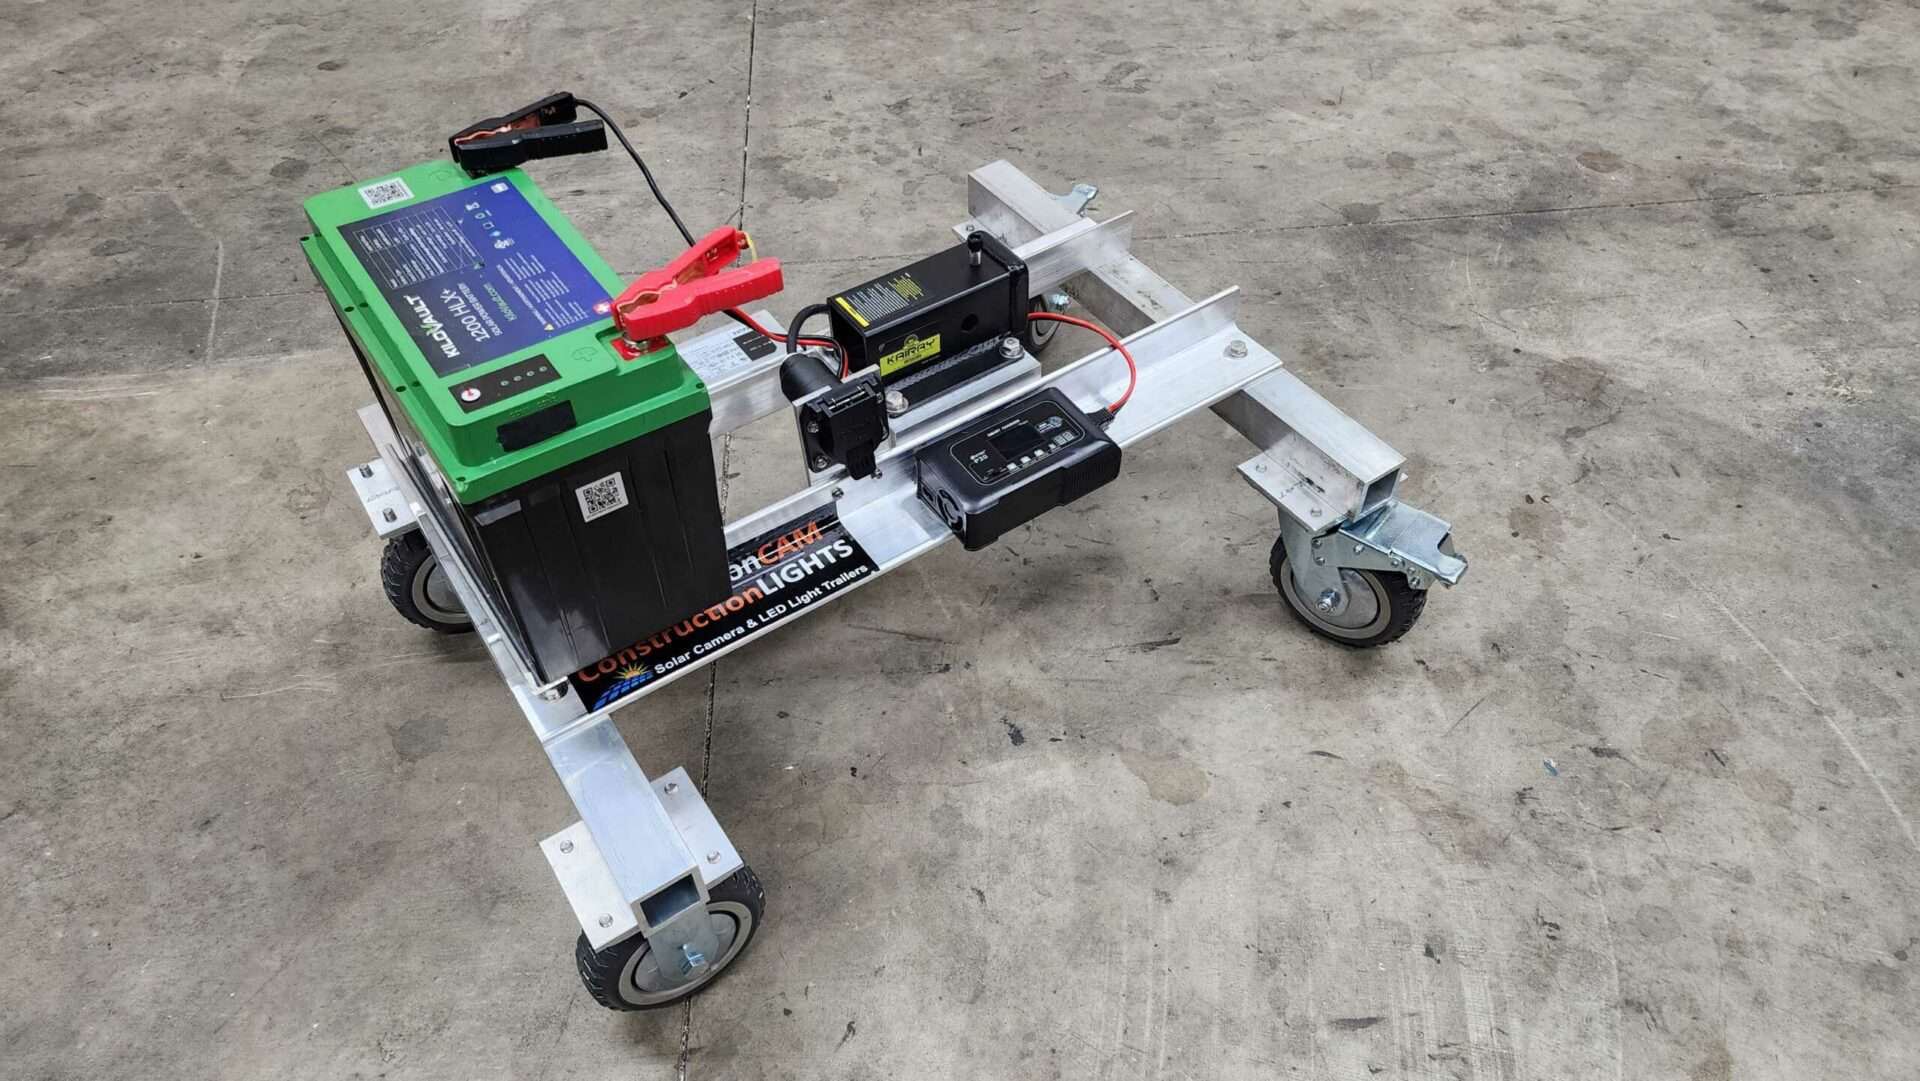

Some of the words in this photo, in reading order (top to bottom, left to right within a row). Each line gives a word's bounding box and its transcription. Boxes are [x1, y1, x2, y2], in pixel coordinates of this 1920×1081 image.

[440, 288, 471, 317] HLX+
[403, 294, 461, 359] KILOVAULT
[461, 314, 491, 343] 1200
[886, 338, 936, 365] KAIRAY
[654, 651, 691, 676] Solar
[693, 626, 745, 655] Camera
[746, 618, 759, 629] &
[758, 604, 787, 623] LED
[789, 586, 823, 609] Light
[821, 564, 869, 591] Trailers
